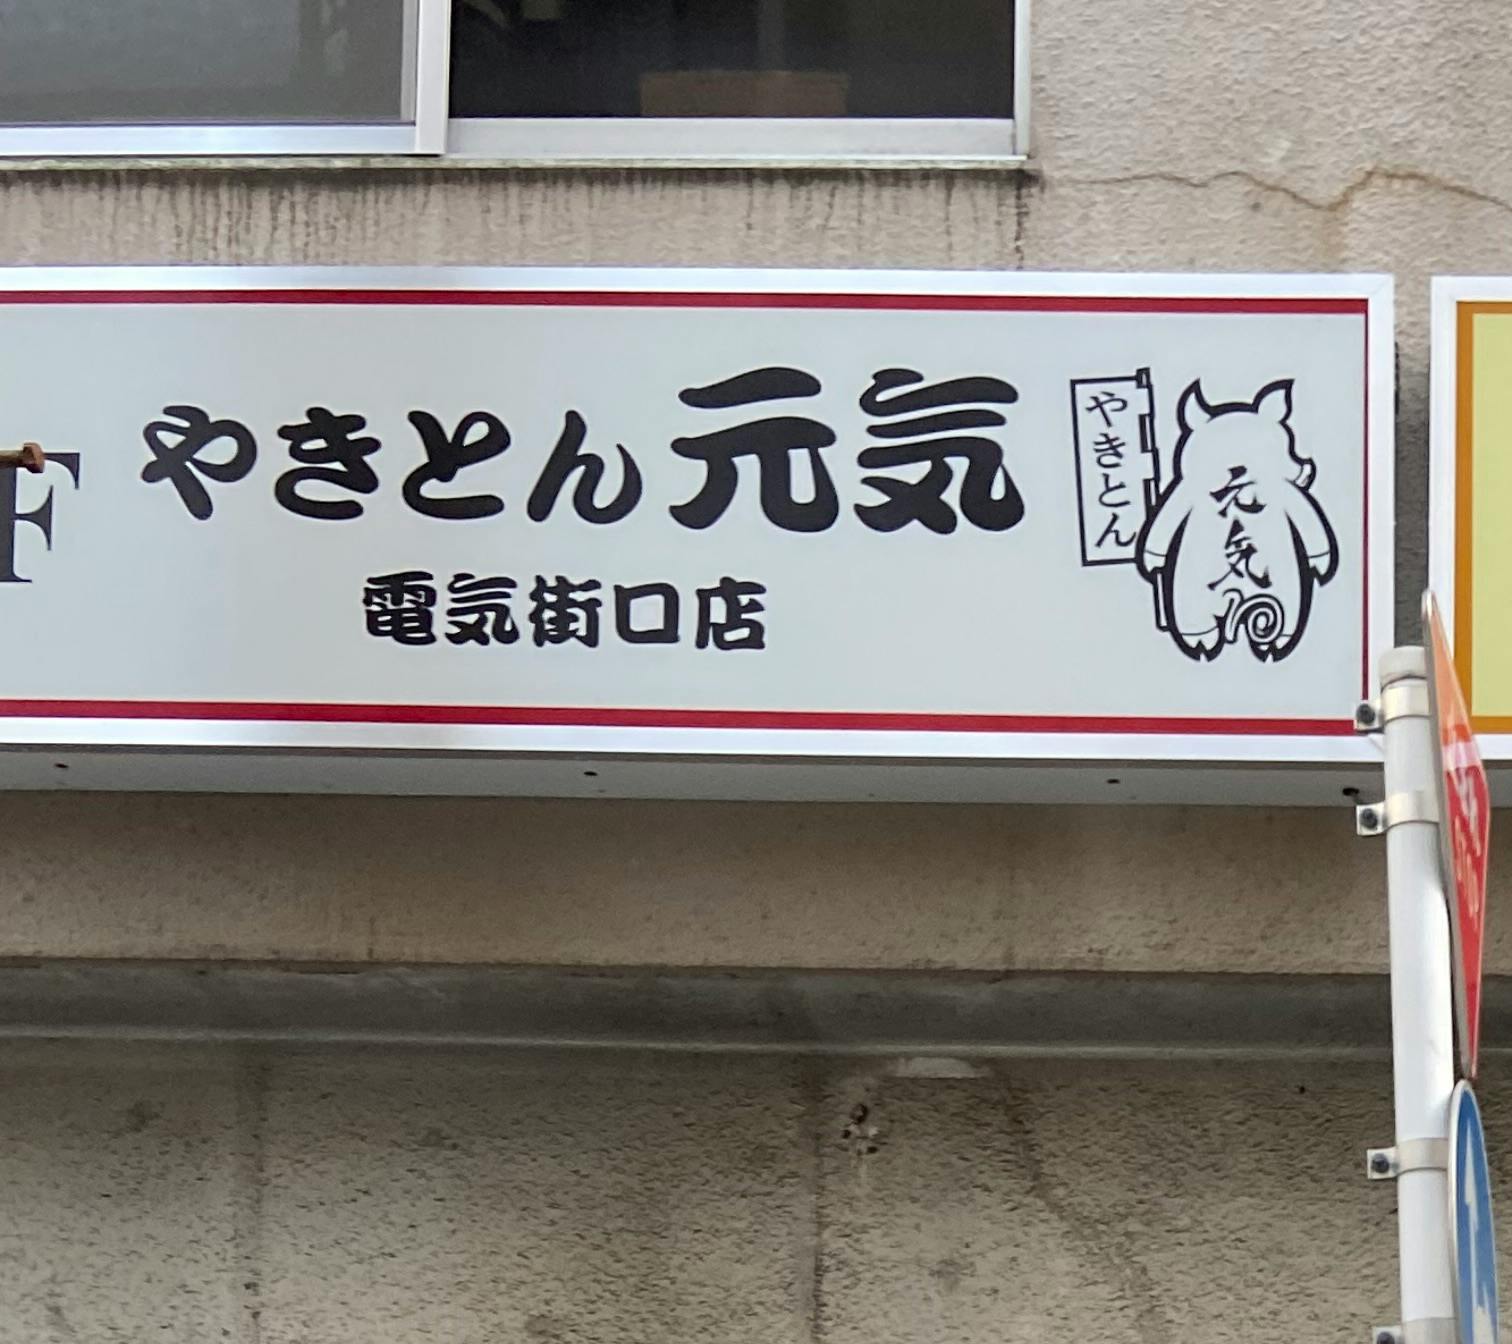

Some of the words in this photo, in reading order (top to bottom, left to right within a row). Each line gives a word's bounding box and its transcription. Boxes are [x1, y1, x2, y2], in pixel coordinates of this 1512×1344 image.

[1085, 391, 1137, 548] やきとん
[1207, 465, 1273, 591] 元気
[362, 569, 768, 652] 電気街口店
